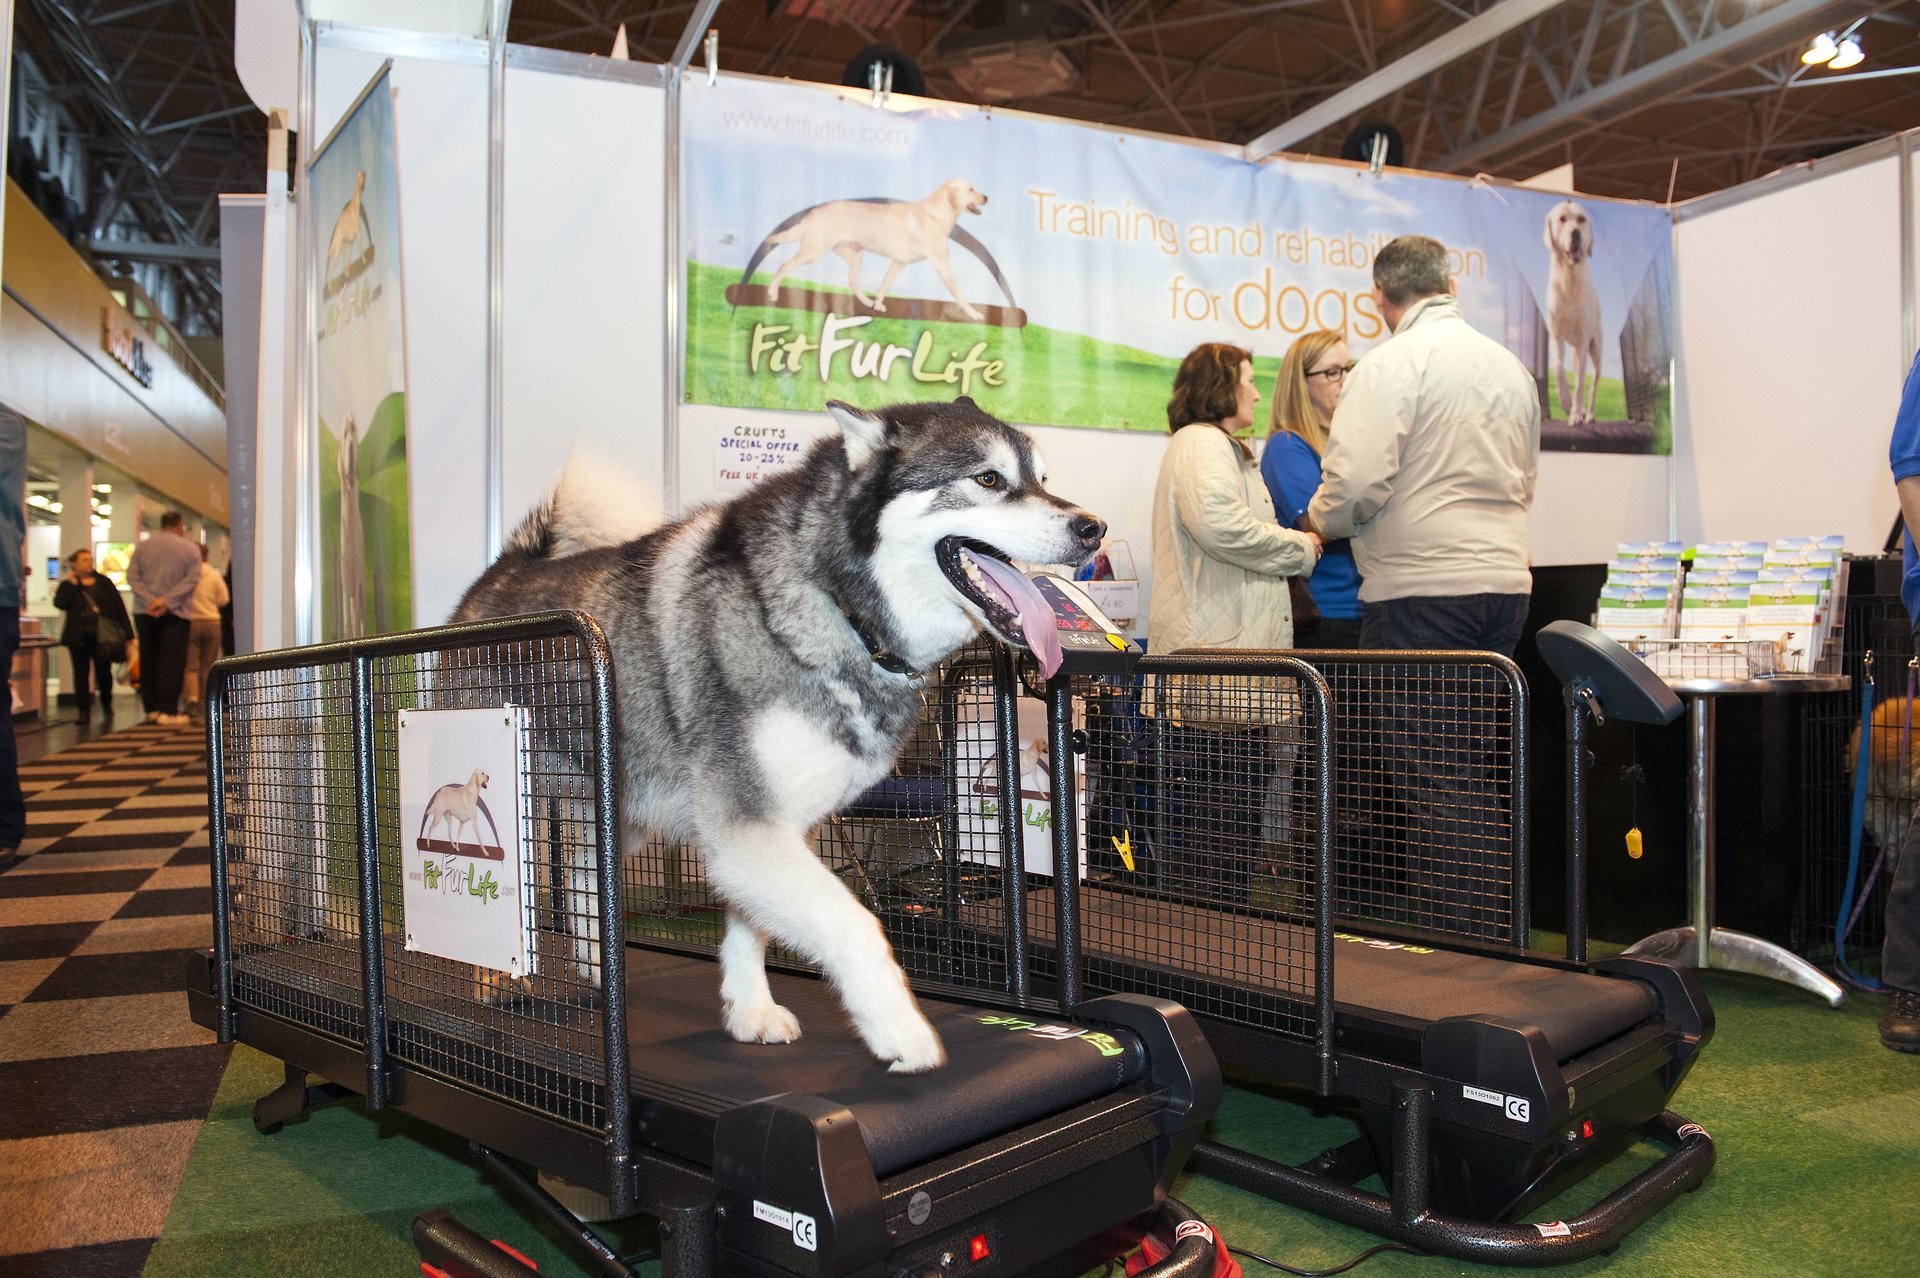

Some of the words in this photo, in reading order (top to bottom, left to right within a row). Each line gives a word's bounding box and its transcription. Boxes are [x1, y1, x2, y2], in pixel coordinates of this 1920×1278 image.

[722, 110, 908, 145] www.fitfurlife.com
[1028, 189, 1178, 254] Training
[1189, 223, 1262, 258] and
[1276, 227, 1485, 278] rehabilon
[1168, 276, 1221, 321] for
[1233, 267, 1383, 344] dogs
[734, 426, 786, 439] CRUFTS
[720, 438, 762, 449] SPECIAL
[766, 442, 799, 452] OFFER
[746, 472, 759, 480] UK
[1508, 1100, 1527, 1119] CE
[796, 1219, 813, 1245] CE
